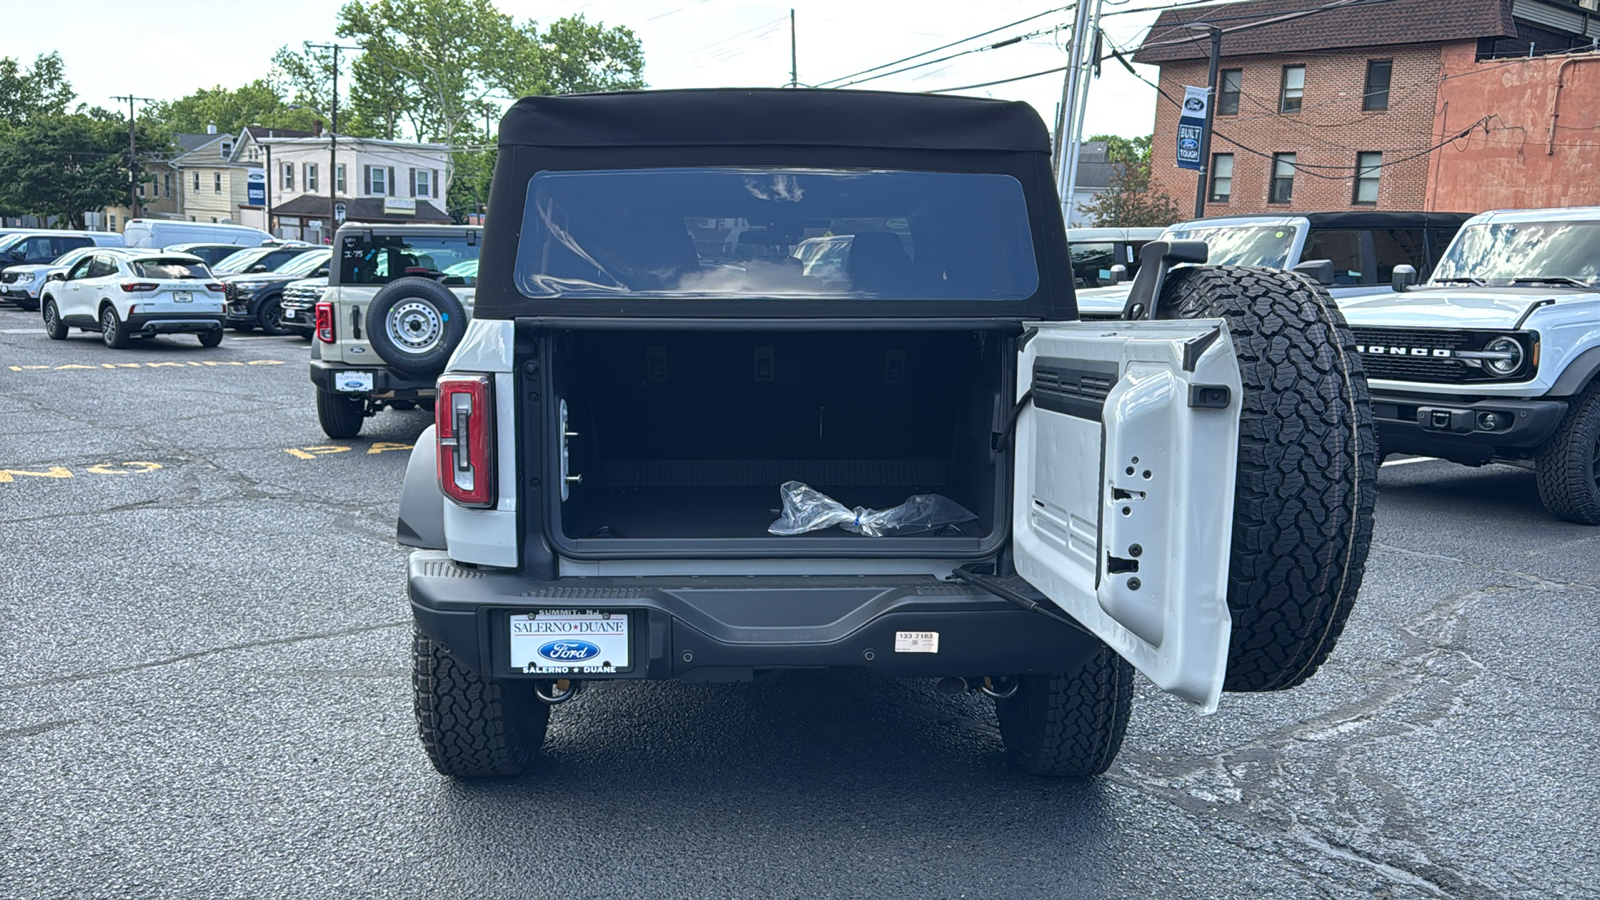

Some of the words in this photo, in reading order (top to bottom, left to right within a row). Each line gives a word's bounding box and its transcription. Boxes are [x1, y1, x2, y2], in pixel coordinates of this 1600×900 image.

[1187, 98, 1202, 110] Ford
[1181, 128, 1199, 139] BUILT
[1180, 149, 1198, 159] TOUGH
[514, 621, 572, 633] SALERNO
[579, 621, 624, 633] DUANE
[550, 642, 588, 659] Ford
[522, 666, 569, 674] SALERNO
